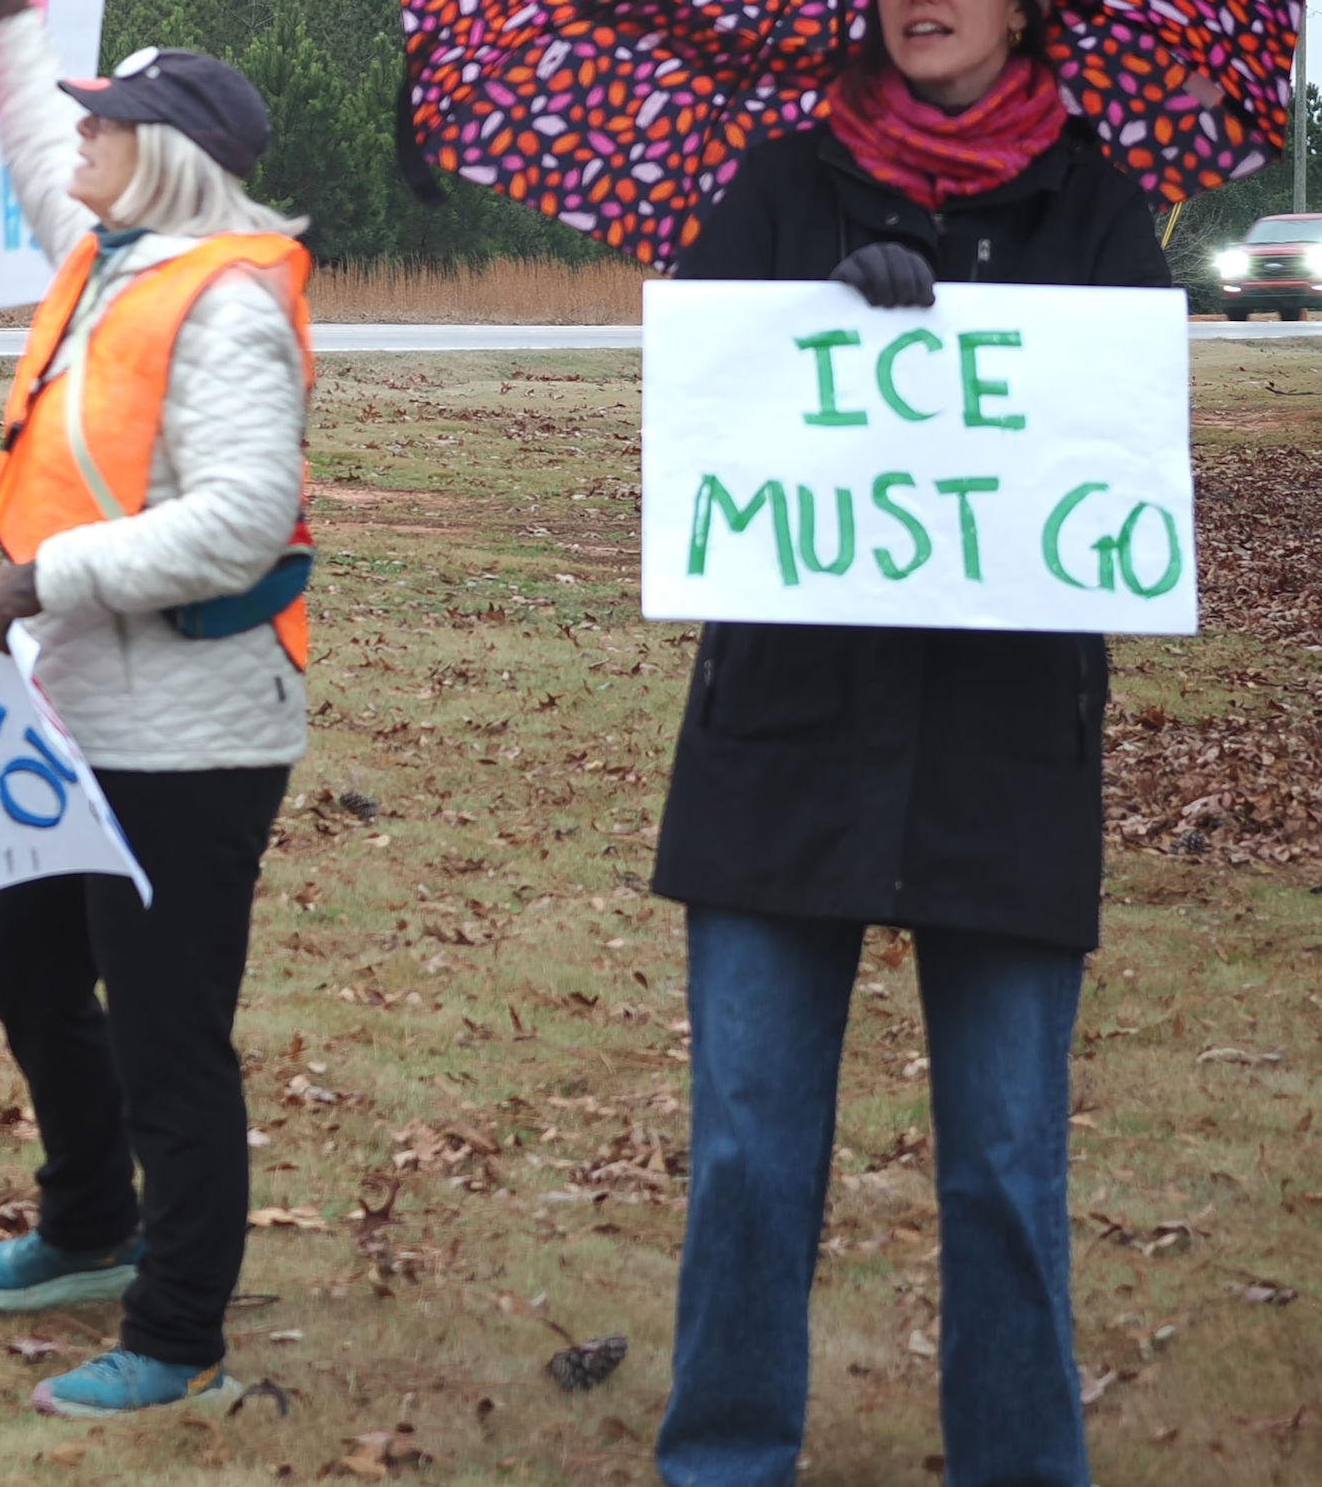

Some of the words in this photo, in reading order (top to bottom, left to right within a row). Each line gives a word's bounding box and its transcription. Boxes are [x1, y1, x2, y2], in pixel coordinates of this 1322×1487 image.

[793, 327, 1027, 430] ICE
[687, 470, 1000, 586] MUST
[1041, 481, 1181, 599] GO
